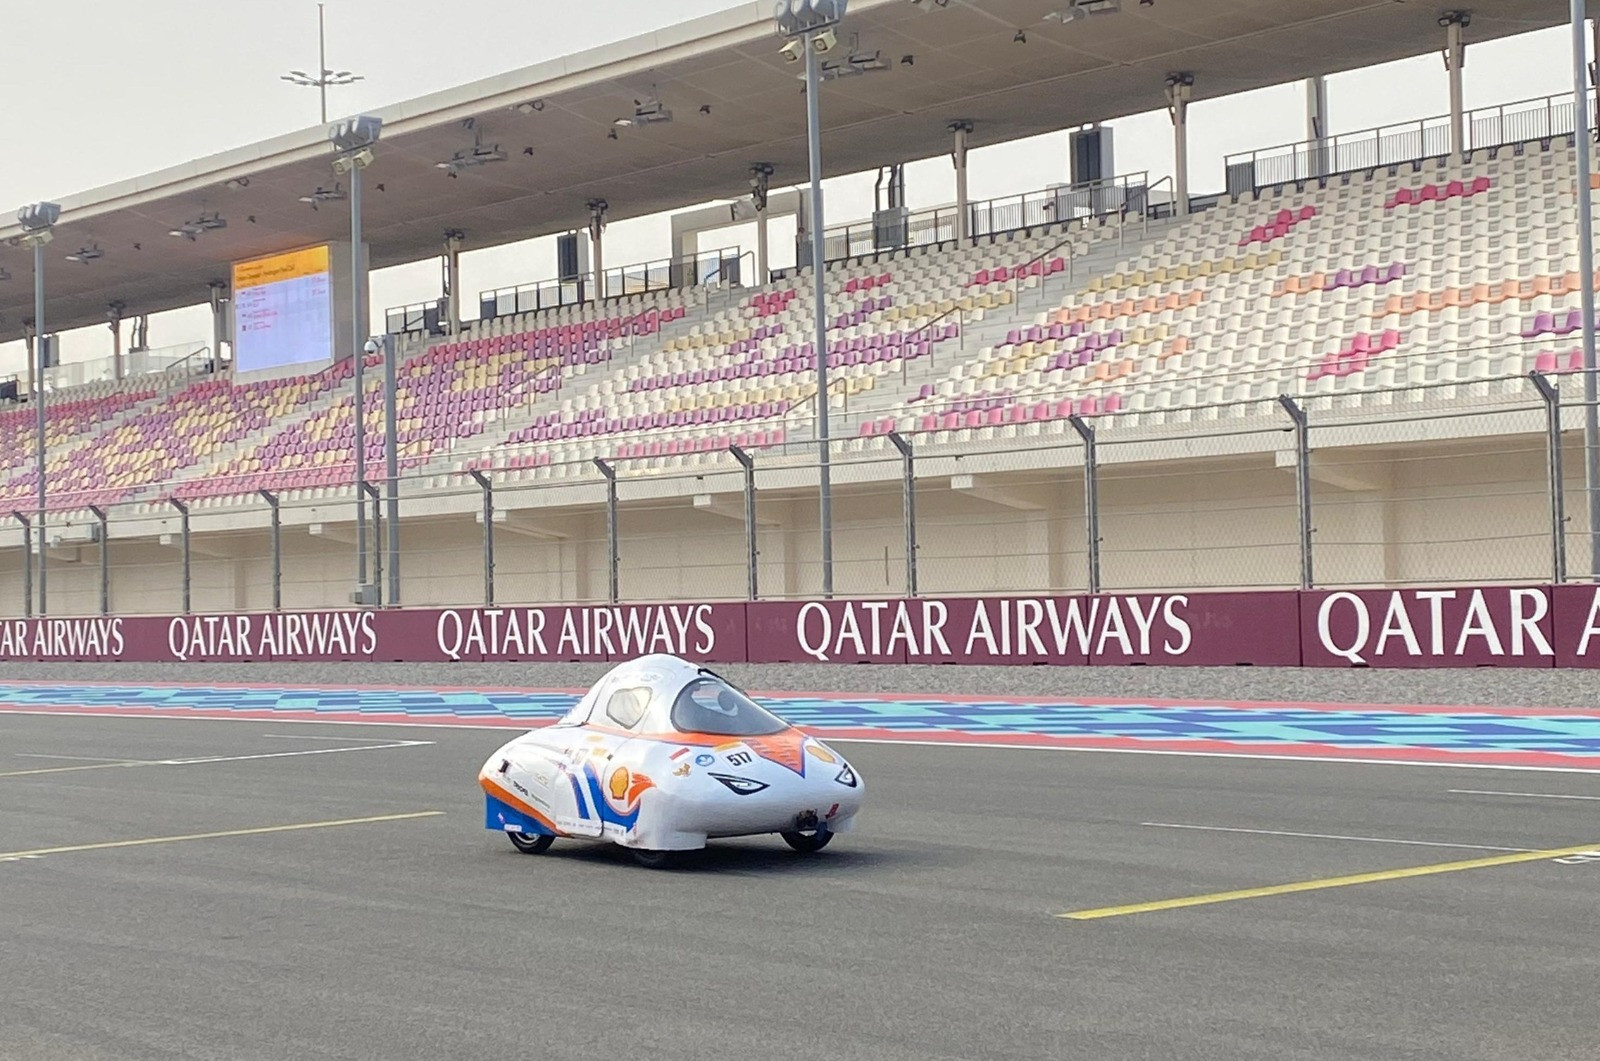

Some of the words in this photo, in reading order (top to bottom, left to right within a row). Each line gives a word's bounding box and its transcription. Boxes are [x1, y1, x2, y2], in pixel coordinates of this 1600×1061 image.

[32, 618, 124, 656] AIRWAYS
[168, 616, 253, 661] QATAR
[258, 611, 377, 656] AIRWAYS
[437, 609, 548, 660] QATAR
[557, 604, 715, 655] AIRWAYS
[796, 600, 952, 661] QATAR
[964, 595, 1191, 655] AIRWAYS
[1317, 588, 1555, 664] QATAR
[726, 751, 752, 766] 517
